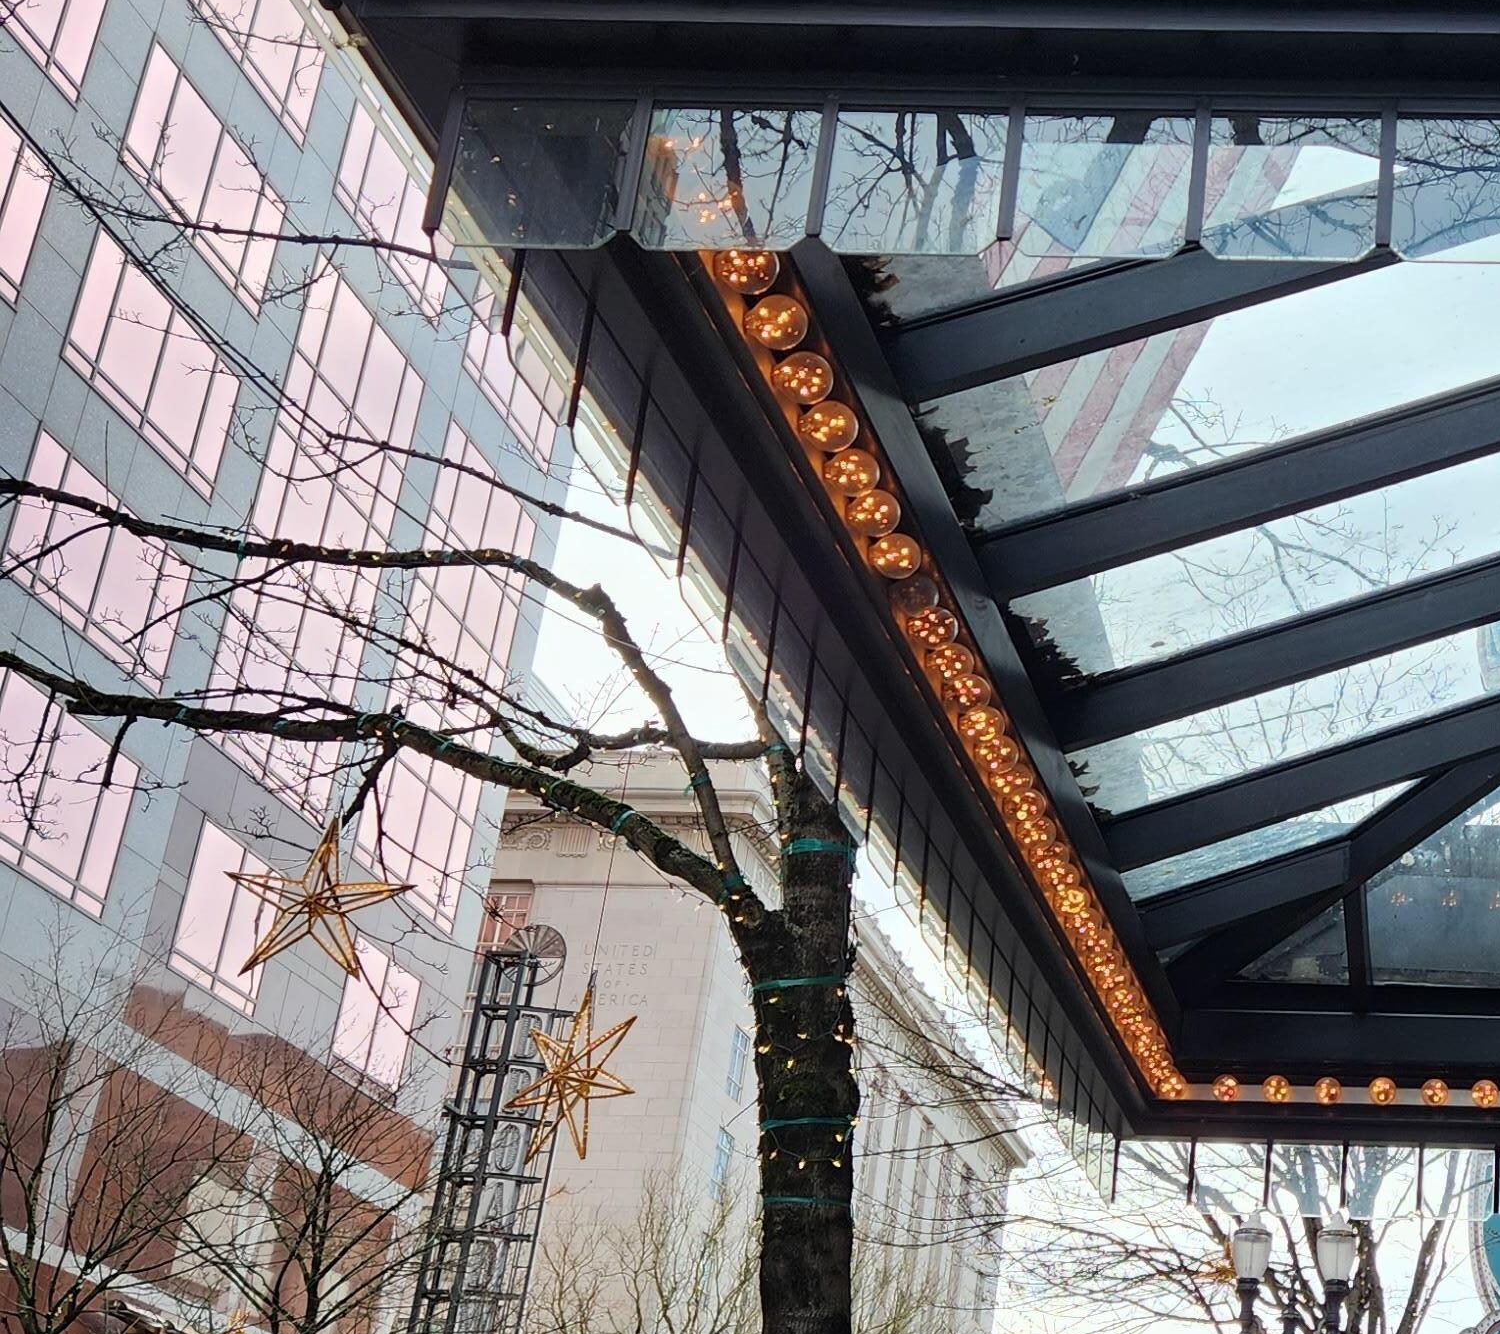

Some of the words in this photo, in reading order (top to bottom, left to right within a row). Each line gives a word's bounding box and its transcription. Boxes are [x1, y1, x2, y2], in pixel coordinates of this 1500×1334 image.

[584, 944, 653, 957] UNITED
[582, 962, 649, 976] STATES
[570, 994, 648, 1007] AERICA
